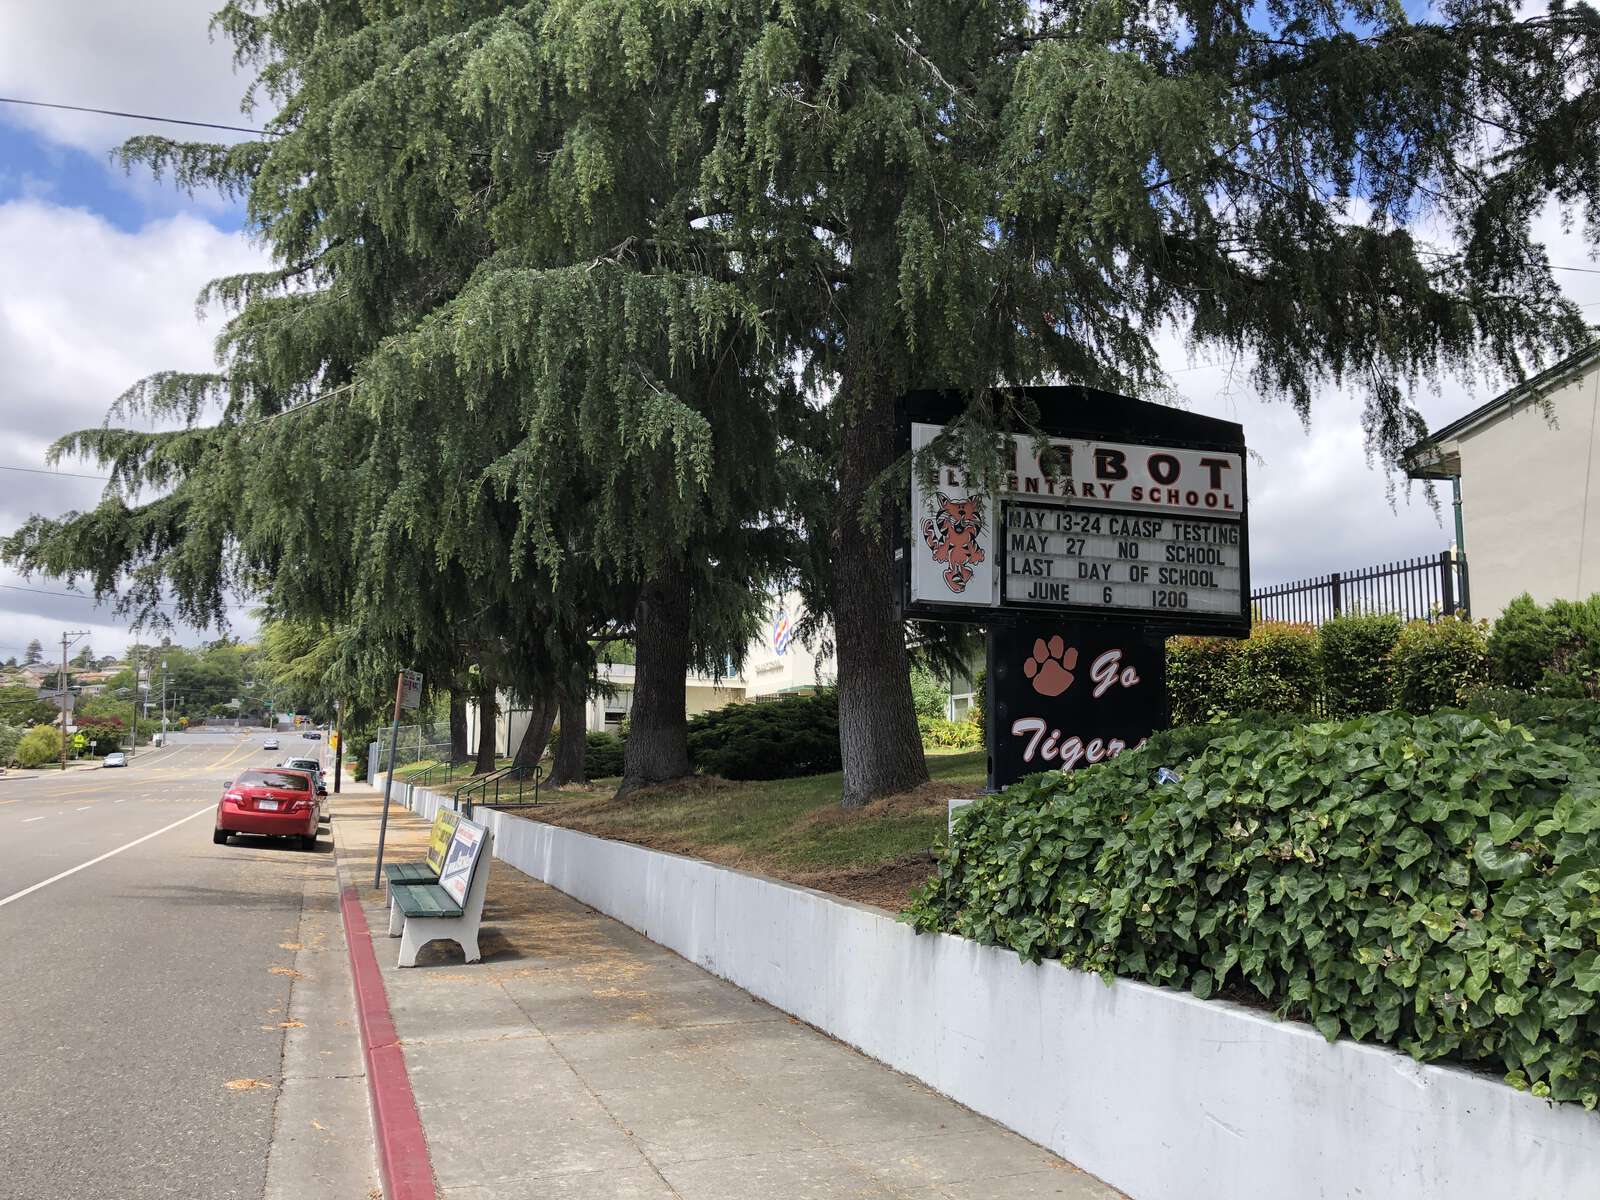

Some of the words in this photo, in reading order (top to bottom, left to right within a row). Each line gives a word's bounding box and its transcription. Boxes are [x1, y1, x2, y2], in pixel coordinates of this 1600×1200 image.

[1131, 486, 1234, 510] SCHOOL
[1007, 511, 1045, 529] MAY
[1057, 514, 1101, 533] 13-24
[1110, 517, 1162, 538] CAASP
[1172, 523, 1238, 545] TESTING
[1011, 534, 1048, 553] MAY
[1066, 538, 1085, 555] 27
[1118, 541, 1139, 559] NO
[1166, 545, 1225, 566] SCHOOL
[1011, 557, 1054, 577] LAST
[1078, 561, 1111, 580] DAY
[1129, 565, 1149, 583] OF
[1158, 567, 1219, 588] SCHOOL
[1028, 582, 1069, 601] JUNE
[1103, 586, 1112, 604] 6
[1152, 590, 1188, 609] 1200
[1090, 649, 1140, 698] Go
